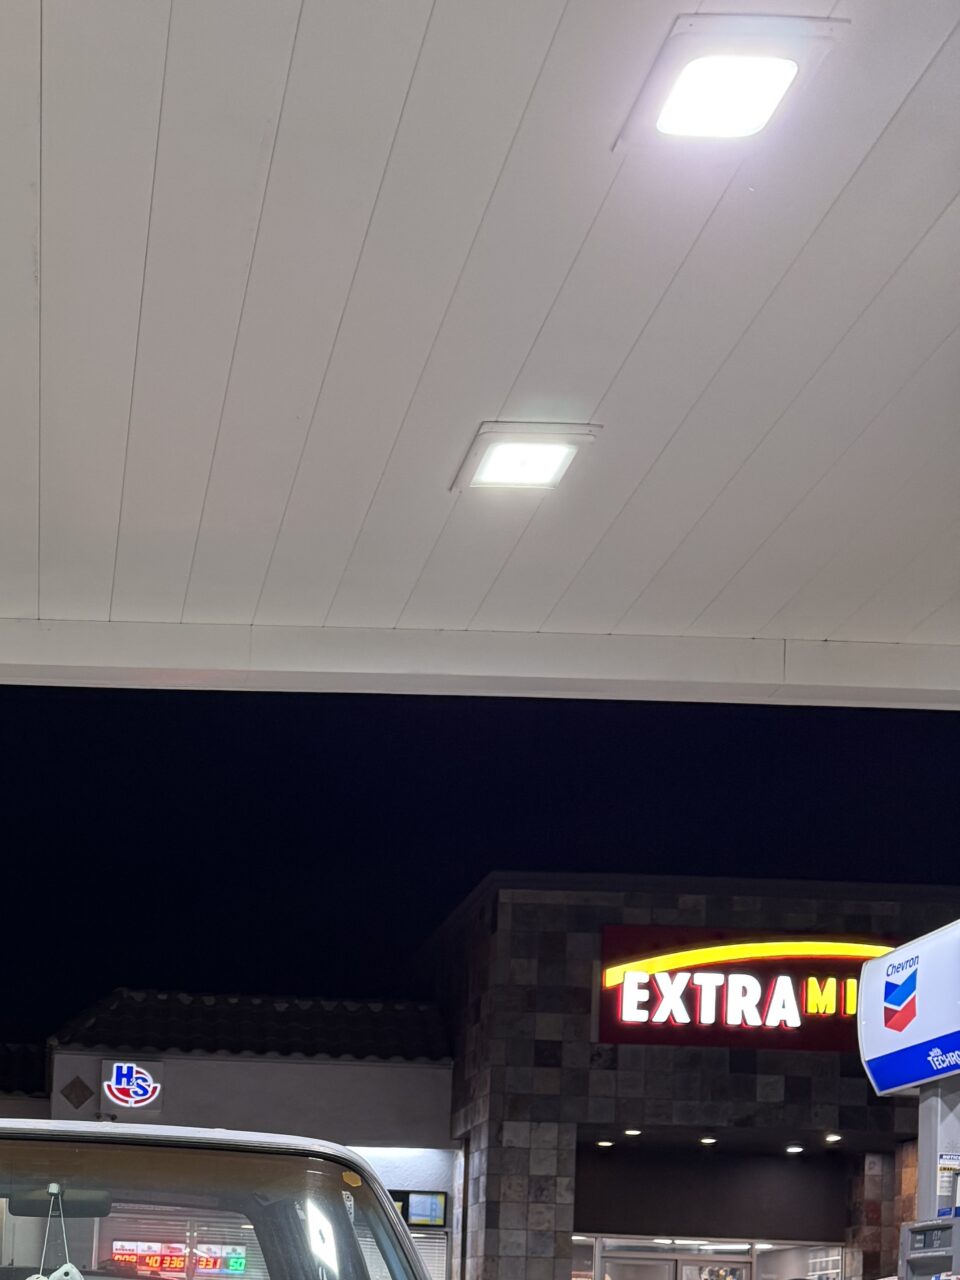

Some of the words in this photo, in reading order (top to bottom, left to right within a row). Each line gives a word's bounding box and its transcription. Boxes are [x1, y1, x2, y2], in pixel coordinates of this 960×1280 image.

[886, 955, 919, 977] Chevron
[621, 971, 801, 1028] EXTRA
[806, 976, 858, 1015] MI
[927, 1050, 960, 1070] TECHRO
[163, 1256, 185, 1268] 336
[228, 1258, 246, 1269] 50
